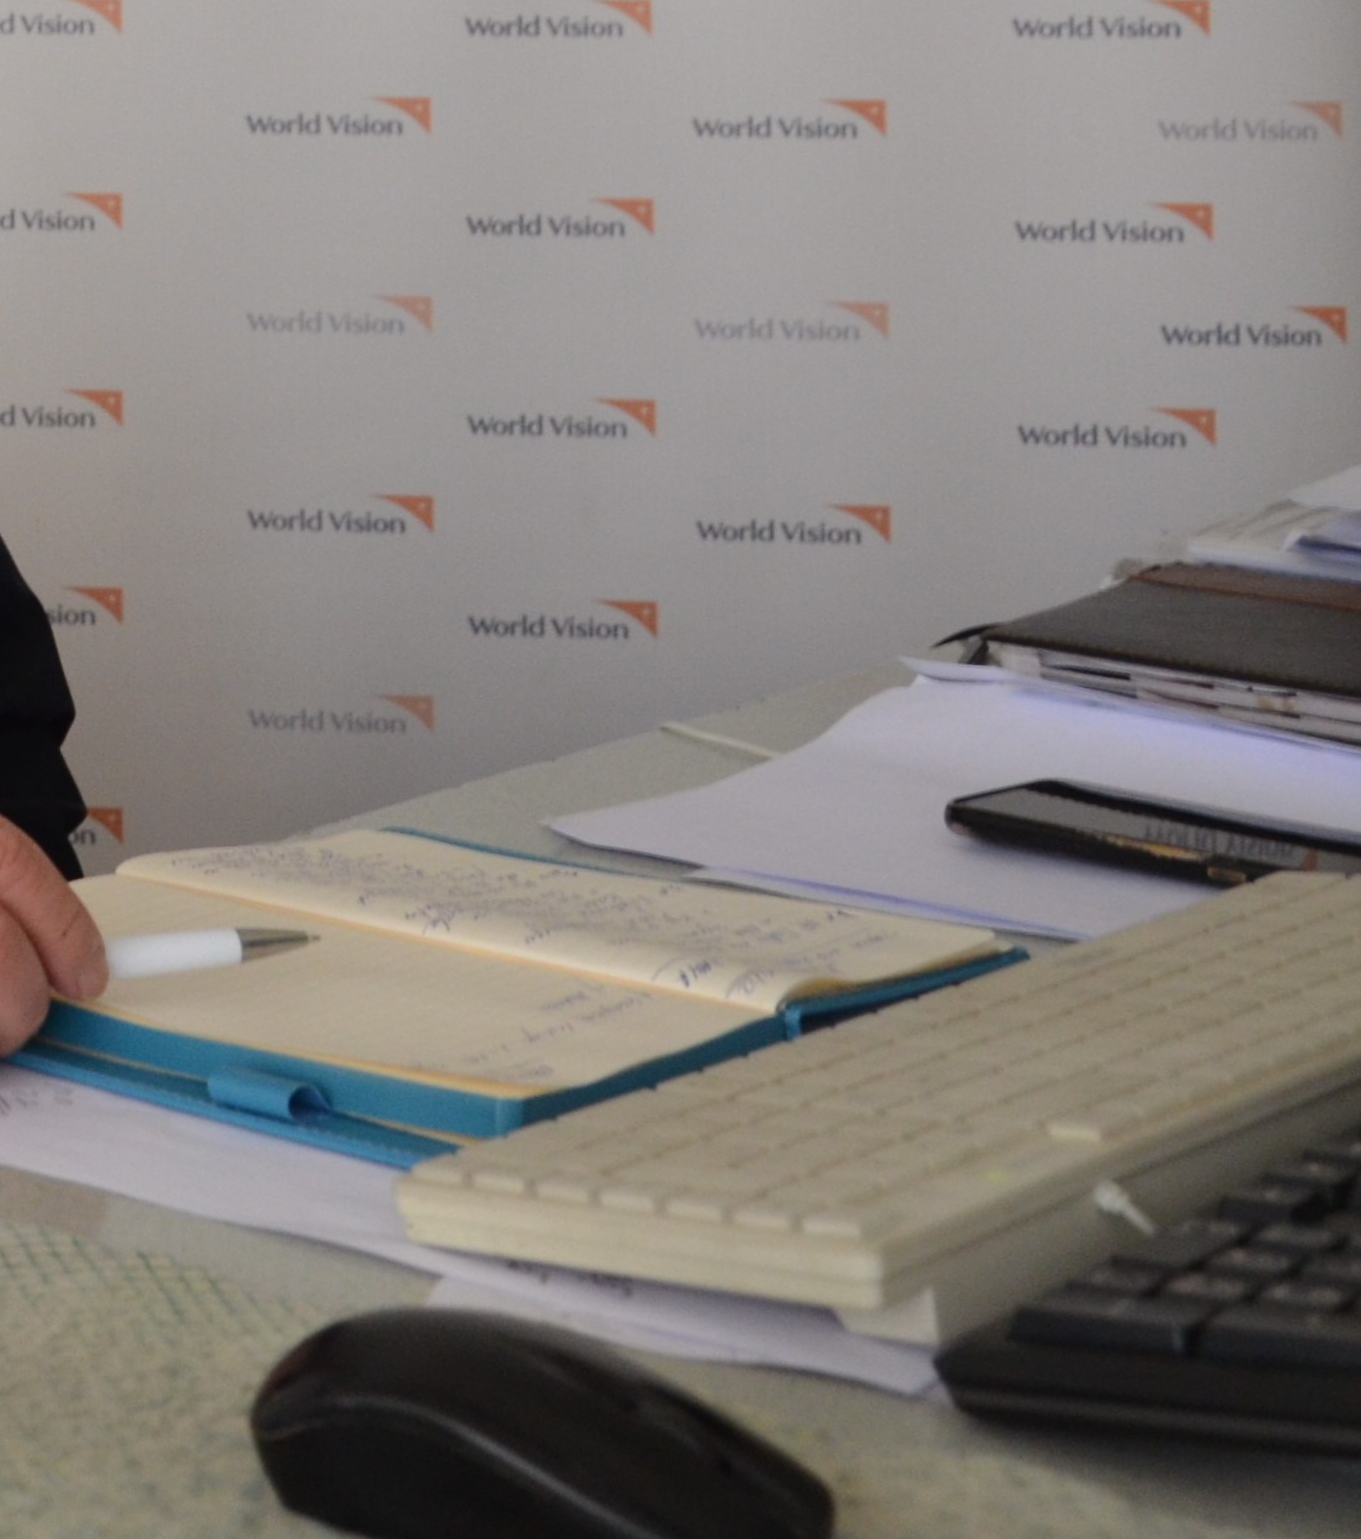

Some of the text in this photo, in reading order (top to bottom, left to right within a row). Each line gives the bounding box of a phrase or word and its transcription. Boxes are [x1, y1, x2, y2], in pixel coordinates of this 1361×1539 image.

[691, 116, 858, 139] World Vision
[1017, 425, 1187, 449] World Vision
[246, 509, 407, 534] World Vision
